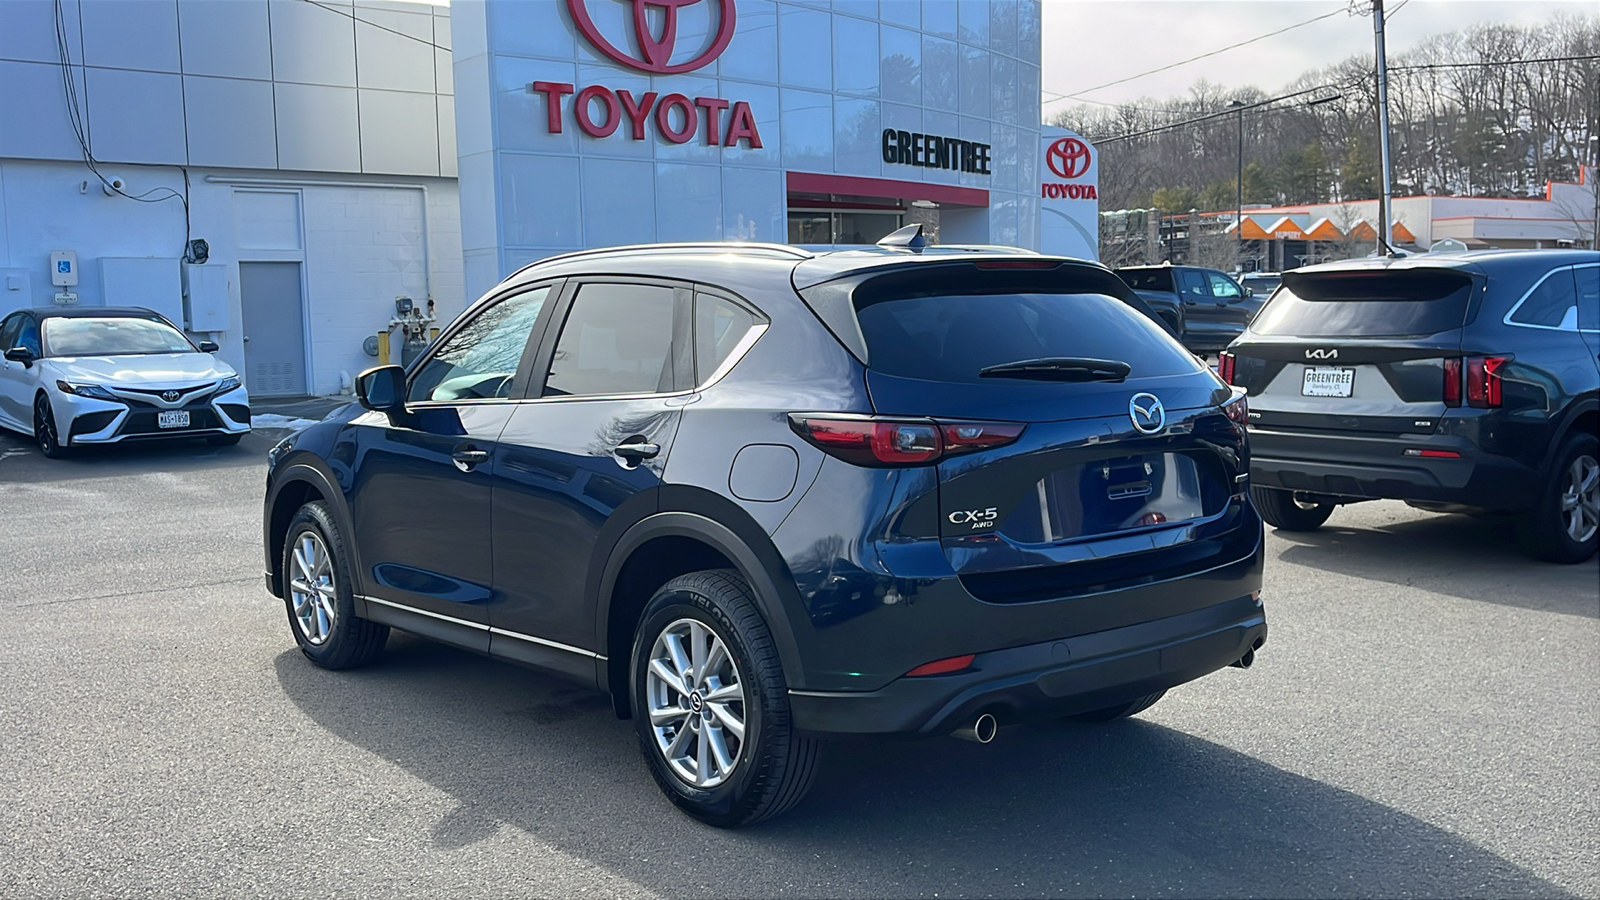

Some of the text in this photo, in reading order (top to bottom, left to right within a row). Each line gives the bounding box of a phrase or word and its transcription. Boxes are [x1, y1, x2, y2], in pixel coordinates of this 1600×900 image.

[533, 81, 763, 149] TOYOTA
[882, 128, 992, 175] GREENTREE
[1041, 183, 1098, 200] TOYOTA
[1306, 373, 1351, 384] GREENTREE
[948, 507, 998, 524] CX-5
[971, 521, 993, 529] AWD
